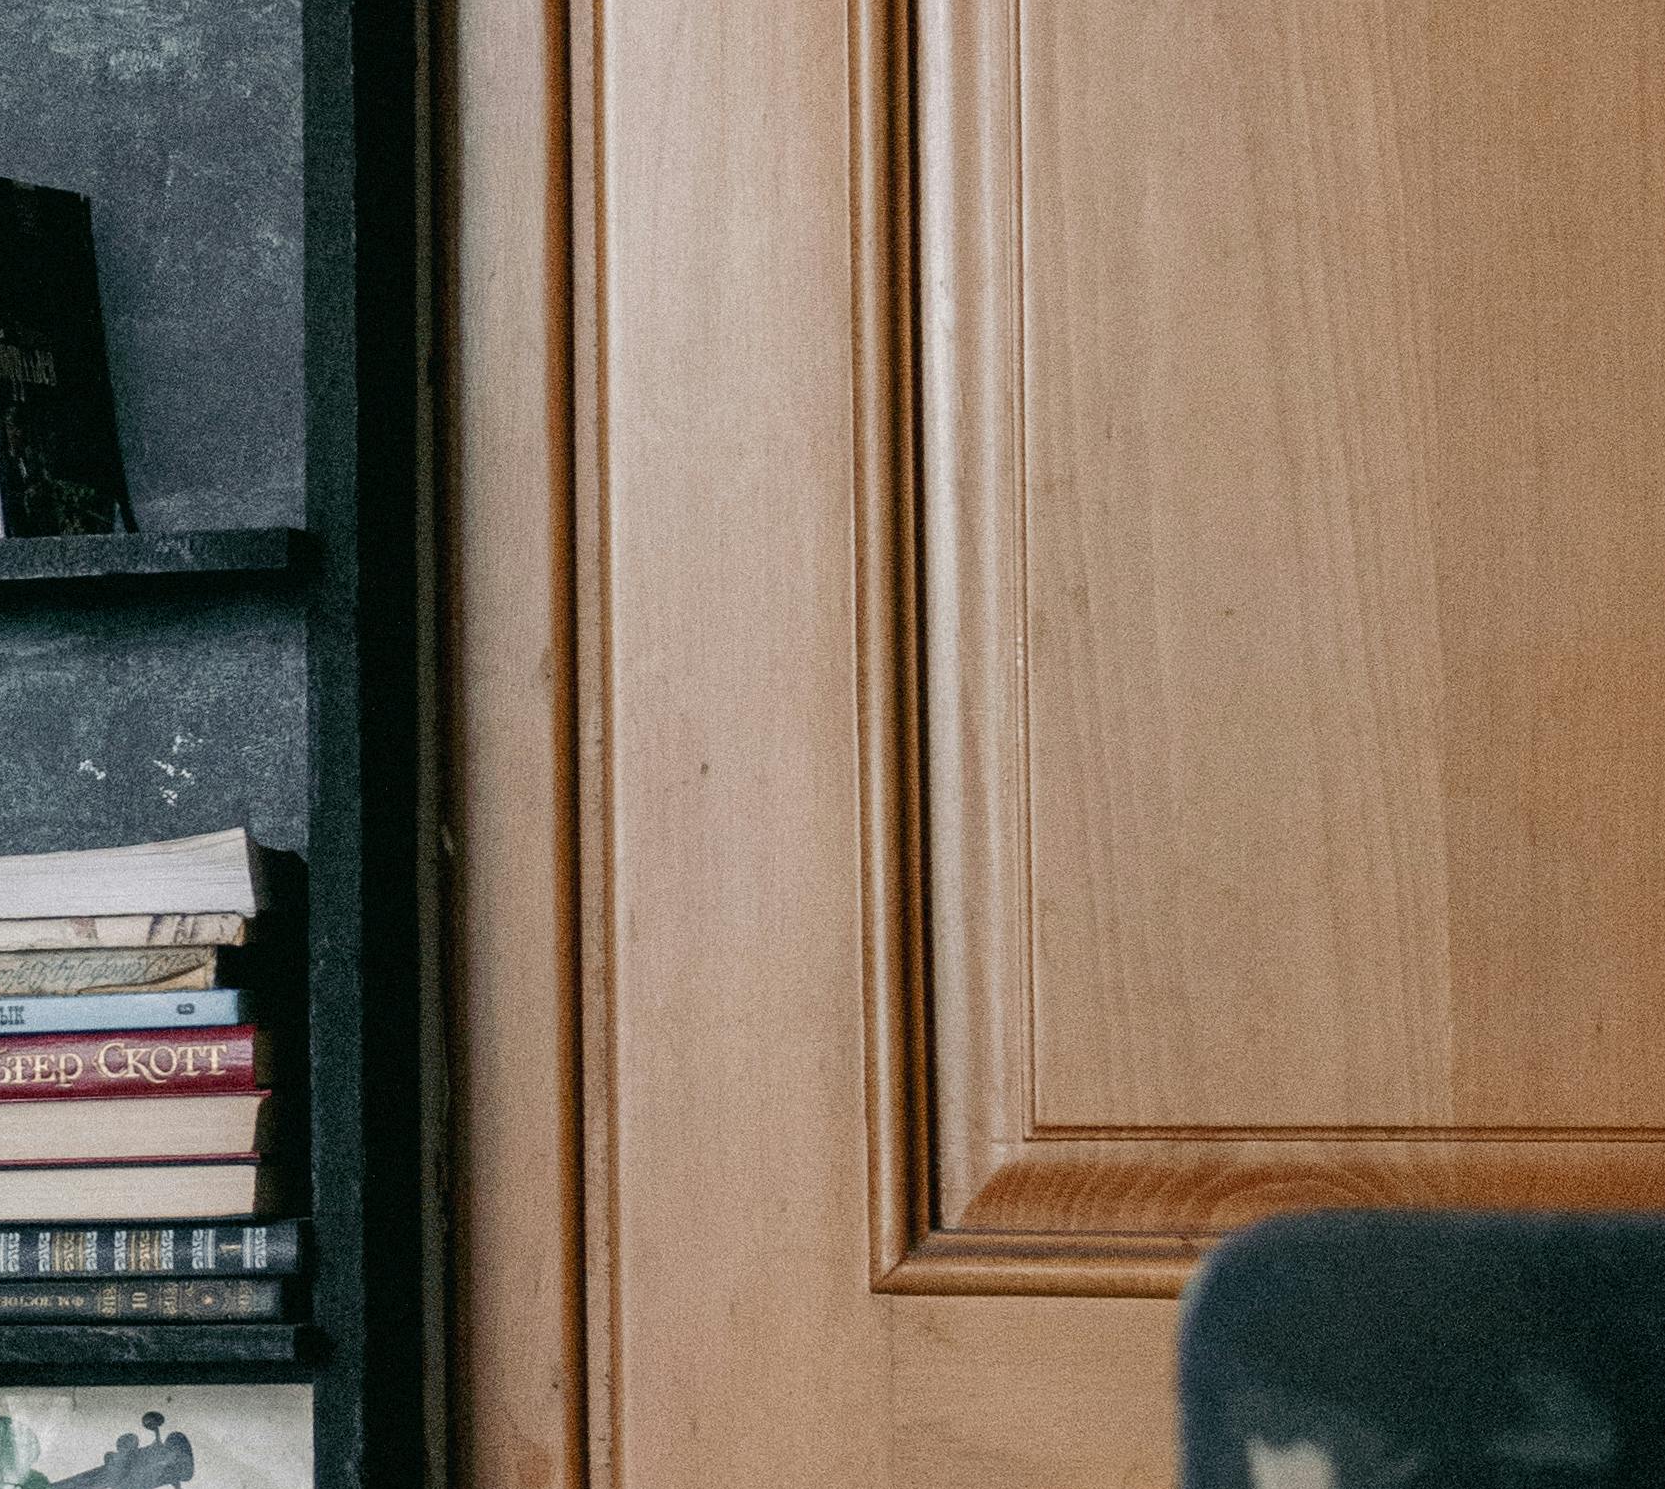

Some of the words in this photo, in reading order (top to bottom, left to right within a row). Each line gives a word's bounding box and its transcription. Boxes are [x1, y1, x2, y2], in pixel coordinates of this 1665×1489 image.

[92, 1041, 228, 1086] СКОТТ
[218, 1242, 243, 1254] 1
[131, 1290, 149, 1310] 10
